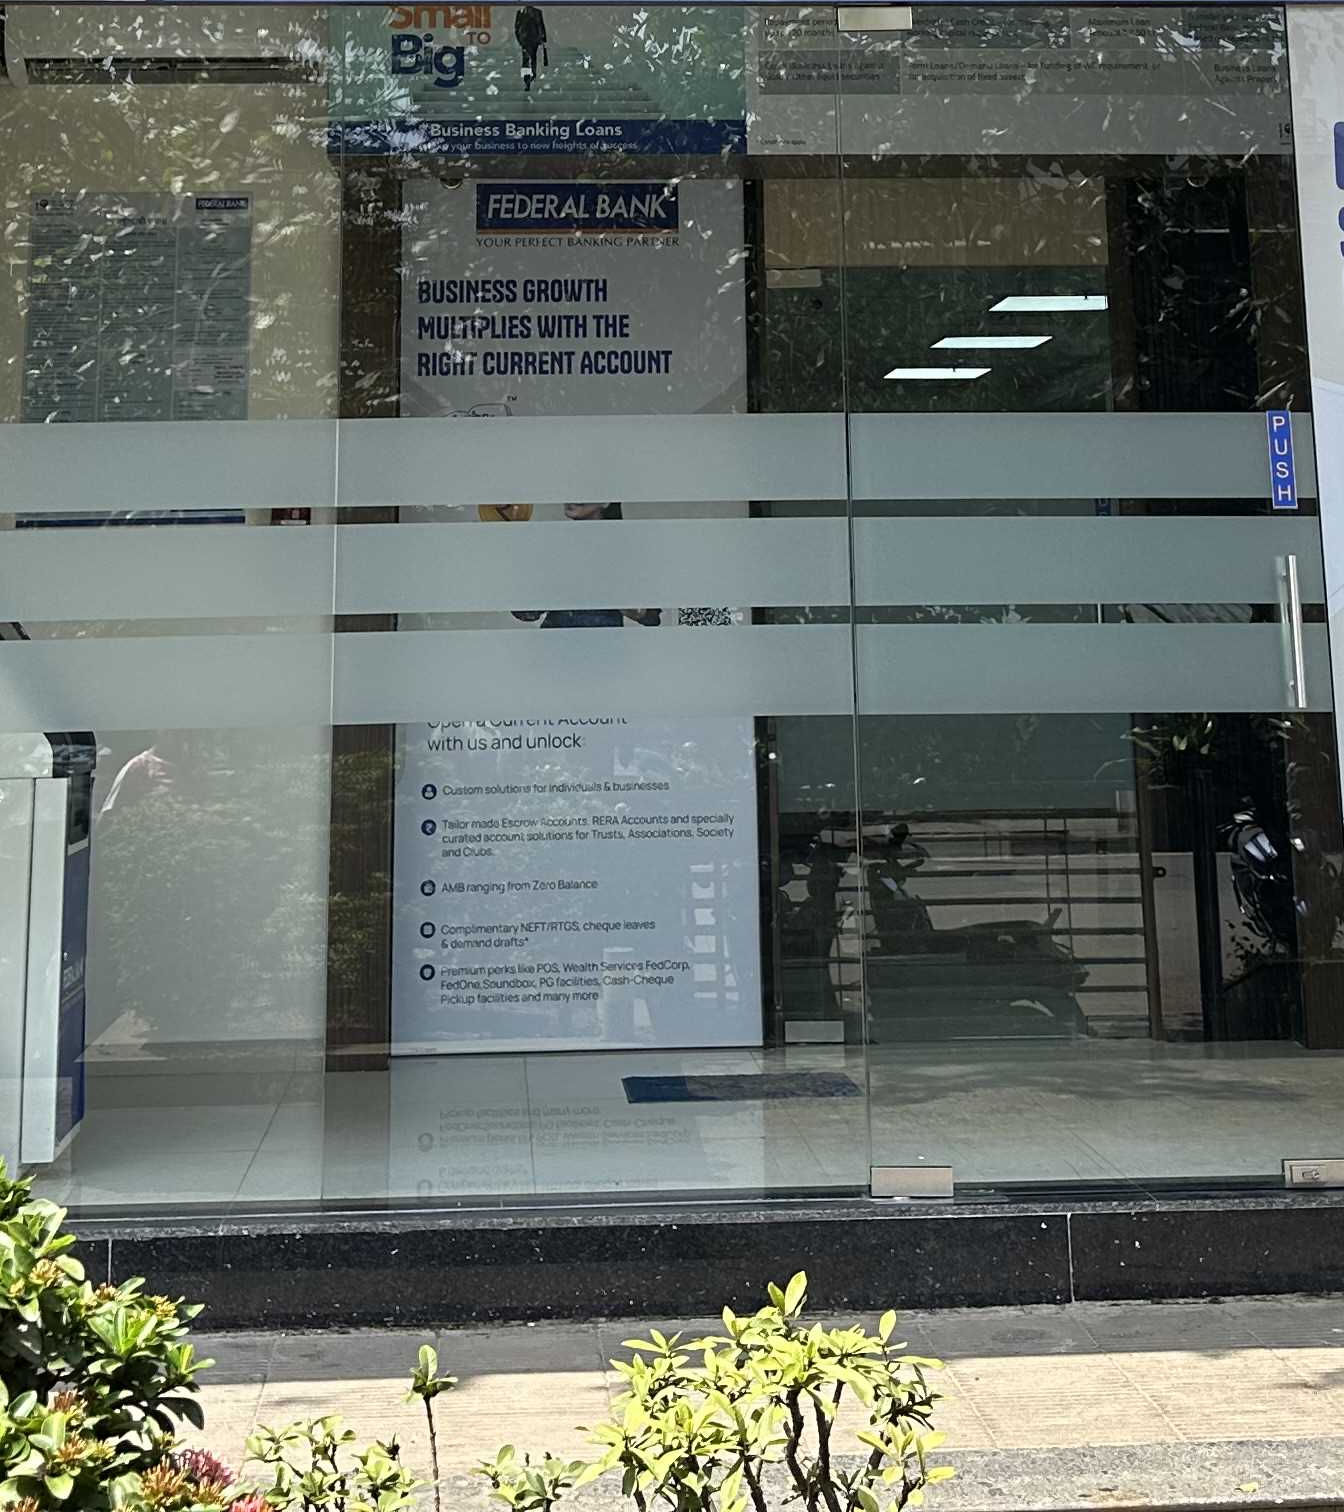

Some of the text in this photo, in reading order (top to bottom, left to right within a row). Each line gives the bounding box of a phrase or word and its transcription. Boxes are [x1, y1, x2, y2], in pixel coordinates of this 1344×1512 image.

[430, 123, 622, 139] Business Banking Loans
[487, 194, 666, 219] FEDERAL BANK
[418, 280, 607, 304] BUSINESS GROWTH
[418, 315, 630, 339] MULTIPLIES WITH THE
[417, 351, 673, 376] RIGHT CURRENT ACCOUNT
[1272, 416, 1292, 501] PUSH
